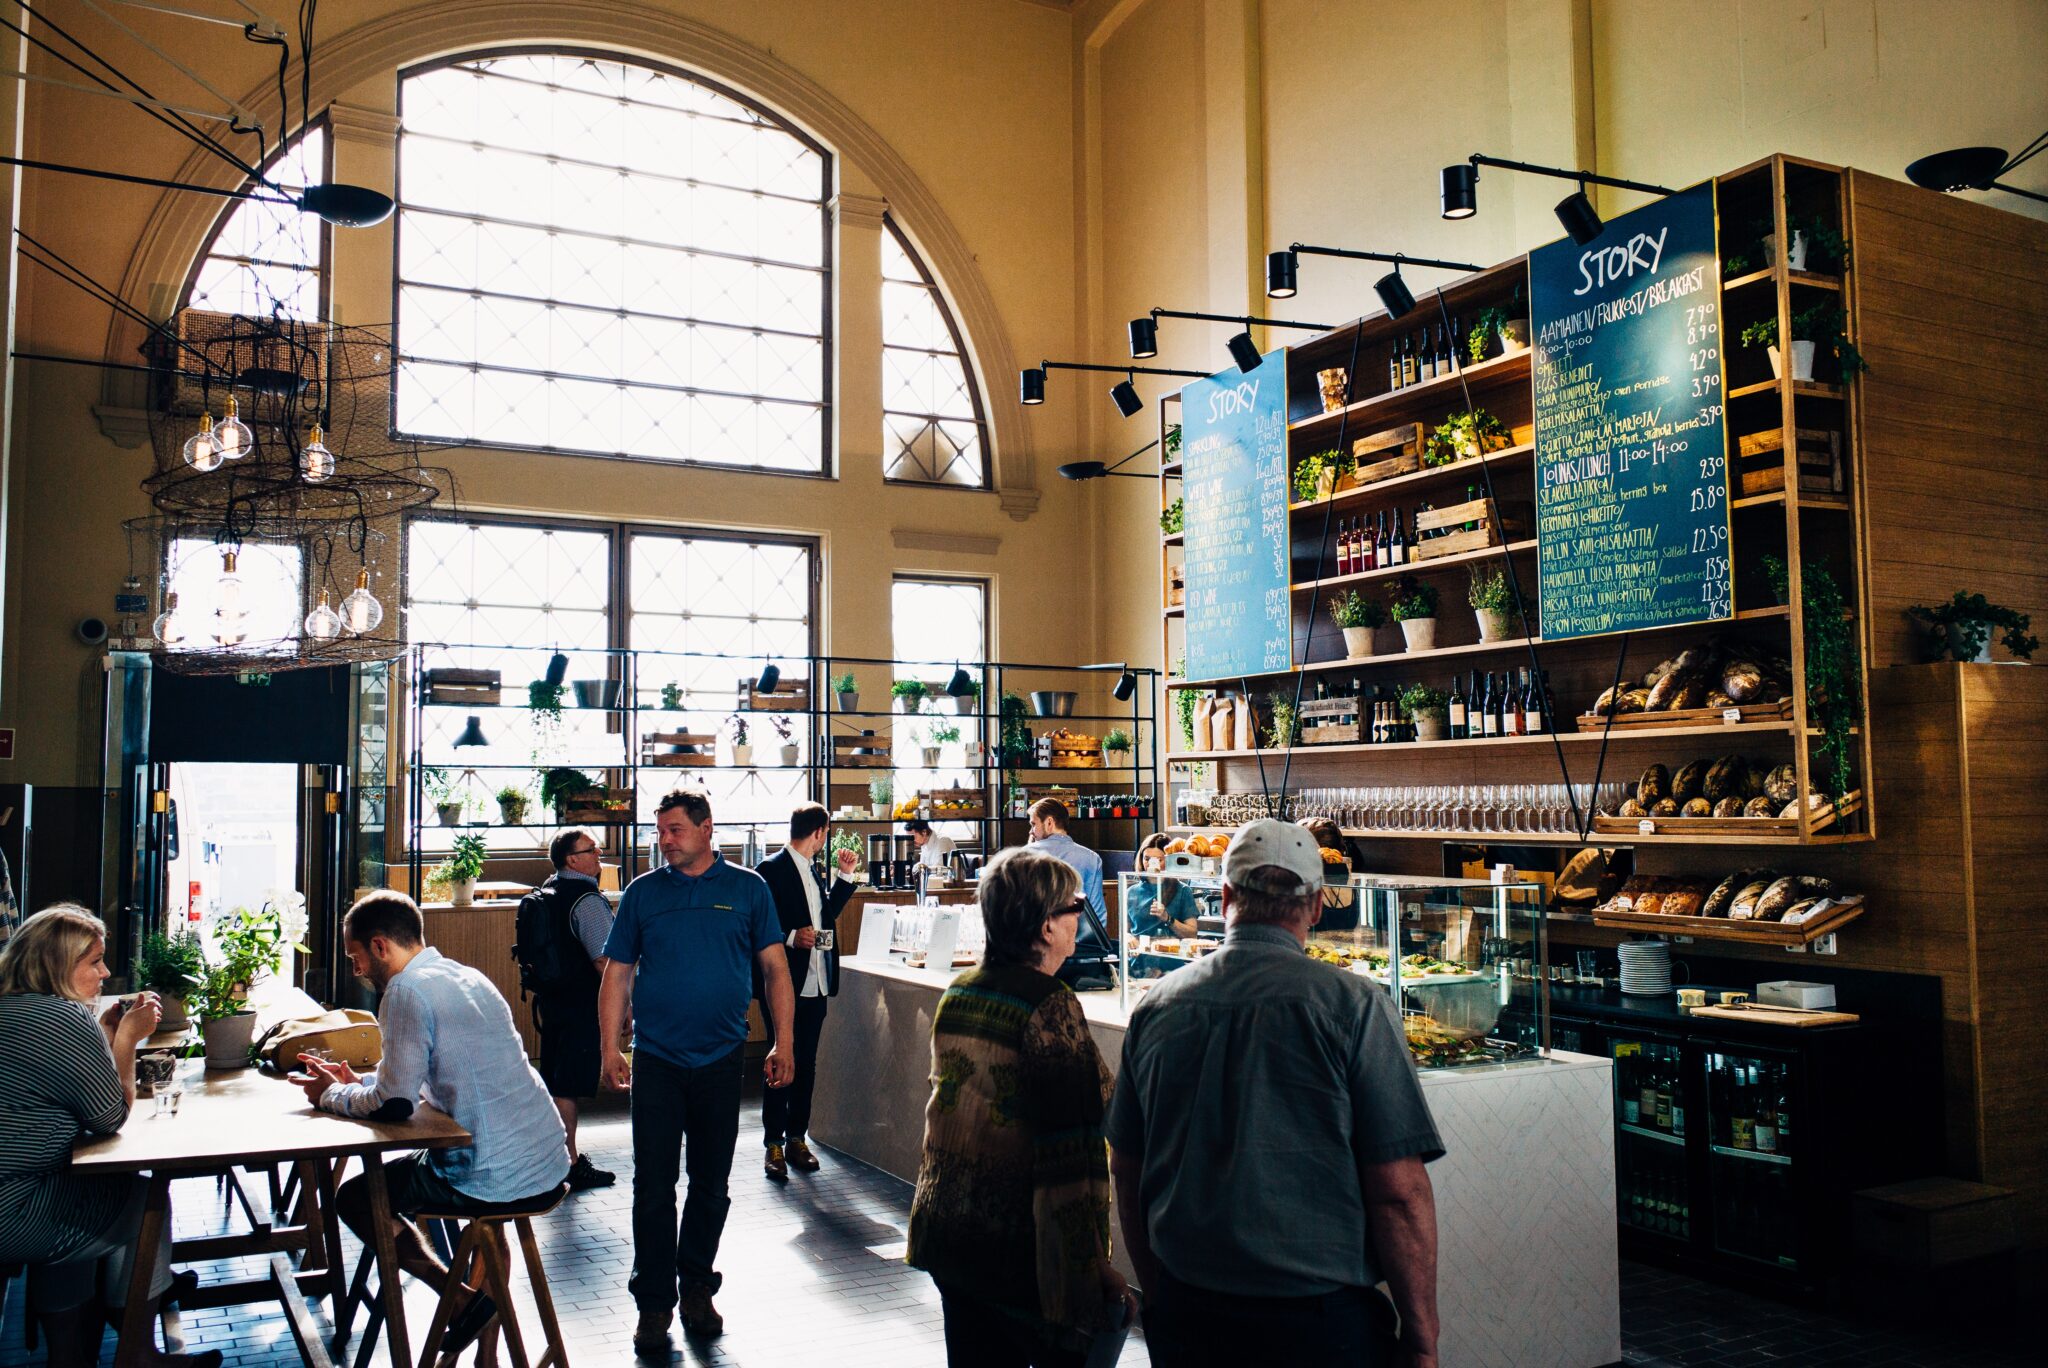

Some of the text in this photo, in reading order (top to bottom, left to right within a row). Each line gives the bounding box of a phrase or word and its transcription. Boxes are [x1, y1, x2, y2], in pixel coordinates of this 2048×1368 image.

[1573, 227, 1668, 296] STORY
[1686, 303, 1715, 328] 7.90
[1687, 323, 1717, 345] 8.90
[1537, 355, 1573, 375] OMELETT
[1536, 363, 1594, 395] EGGS BENEDICT
[1691, 374, 1720, 398] 3.90
[1207, 379, 1260, 425] STORY
[1700, 405, 1723, 427] 3.90
[1700, 457, 1724, 479] 9.30
[1620, 483, 1647, 501] herring
[1653, 479, 1667, 494] box
[1690, 485, 1725, 512] 15.80
[1610, 519, 1630, 533] soup
[1692, 525, 1728, 553] 12.50
[1542, 541, 1568, 561] HALLIN
[1705, 556, 1730, 581] 13.50
[1701, 580, 1730, 602] 11.30
[1707, 599, 1731, 620] 16.50
